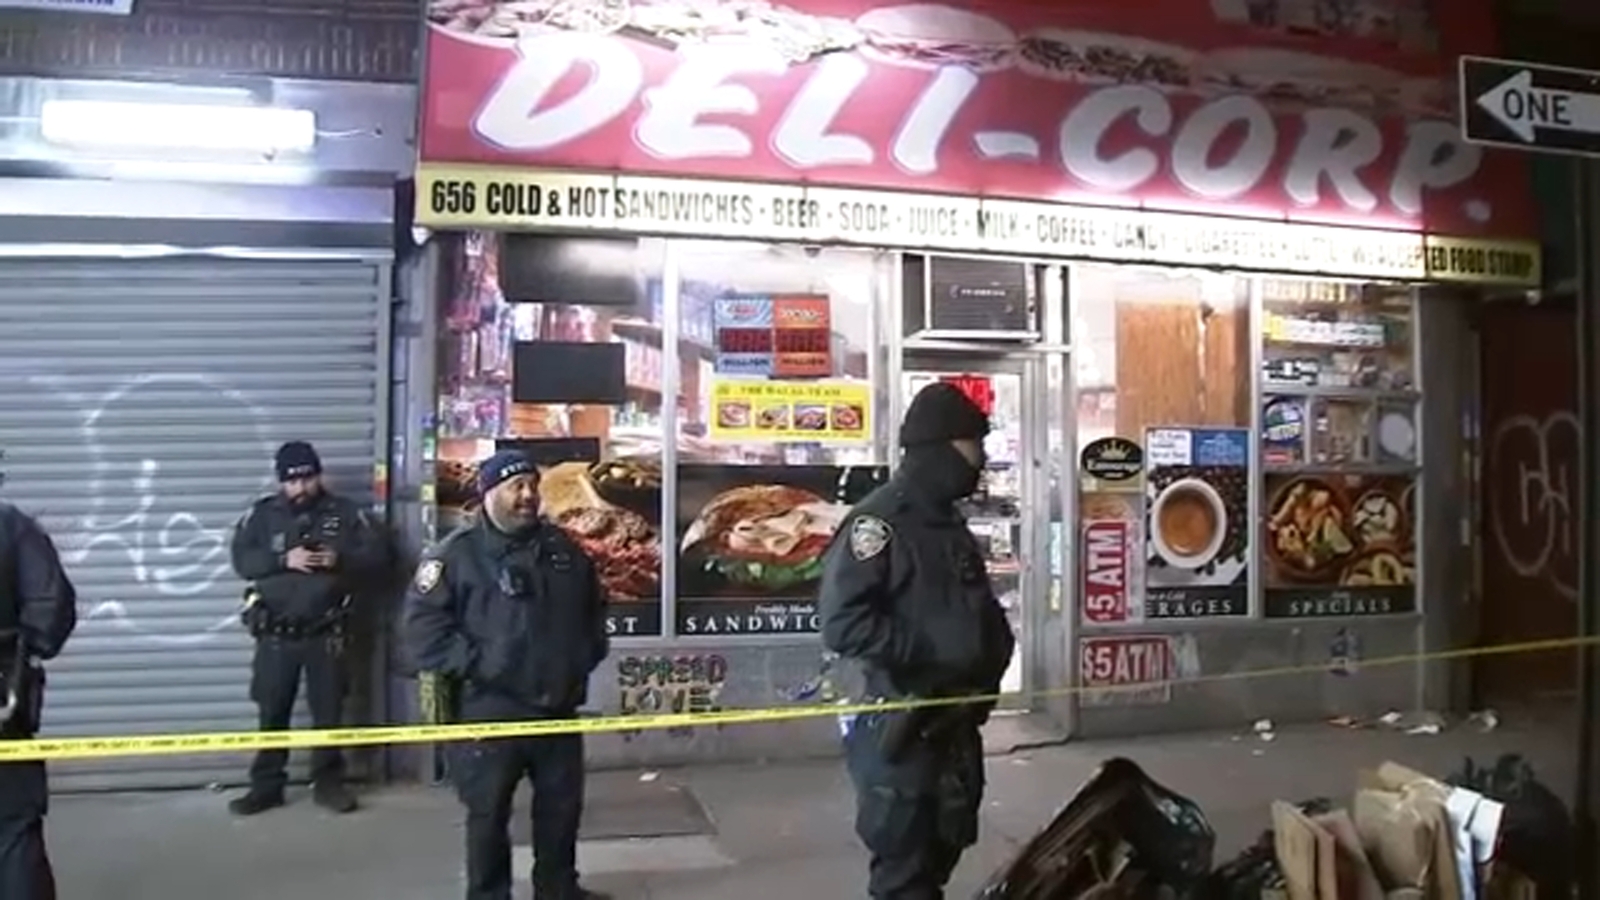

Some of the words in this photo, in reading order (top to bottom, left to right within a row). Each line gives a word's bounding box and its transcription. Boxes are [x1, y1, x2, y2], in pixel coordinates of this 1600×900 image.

[1503, 88, 1572, 126] ONE
[431, 180, 476, 214] 656
[486, 182, 542, 216] COLD
[547, 193, 562, 216] &
[567, 187, 609, 218] HOT
[614, 188, 753, 228] SANDWICHES
[772, 197, 821, 230] BEER
[838, 201, 890, 233] SODA
[909, 206, 960, 237] JUICE
[976, 208, 1020, 240] MILK
[1036, 214, 1097, 247] COFFEE
[1450, 246, 1487, 275] FOOD
[1086, 528, 1124, 588] ATM
[1289, 598, 1392, 617] SPECIALS
